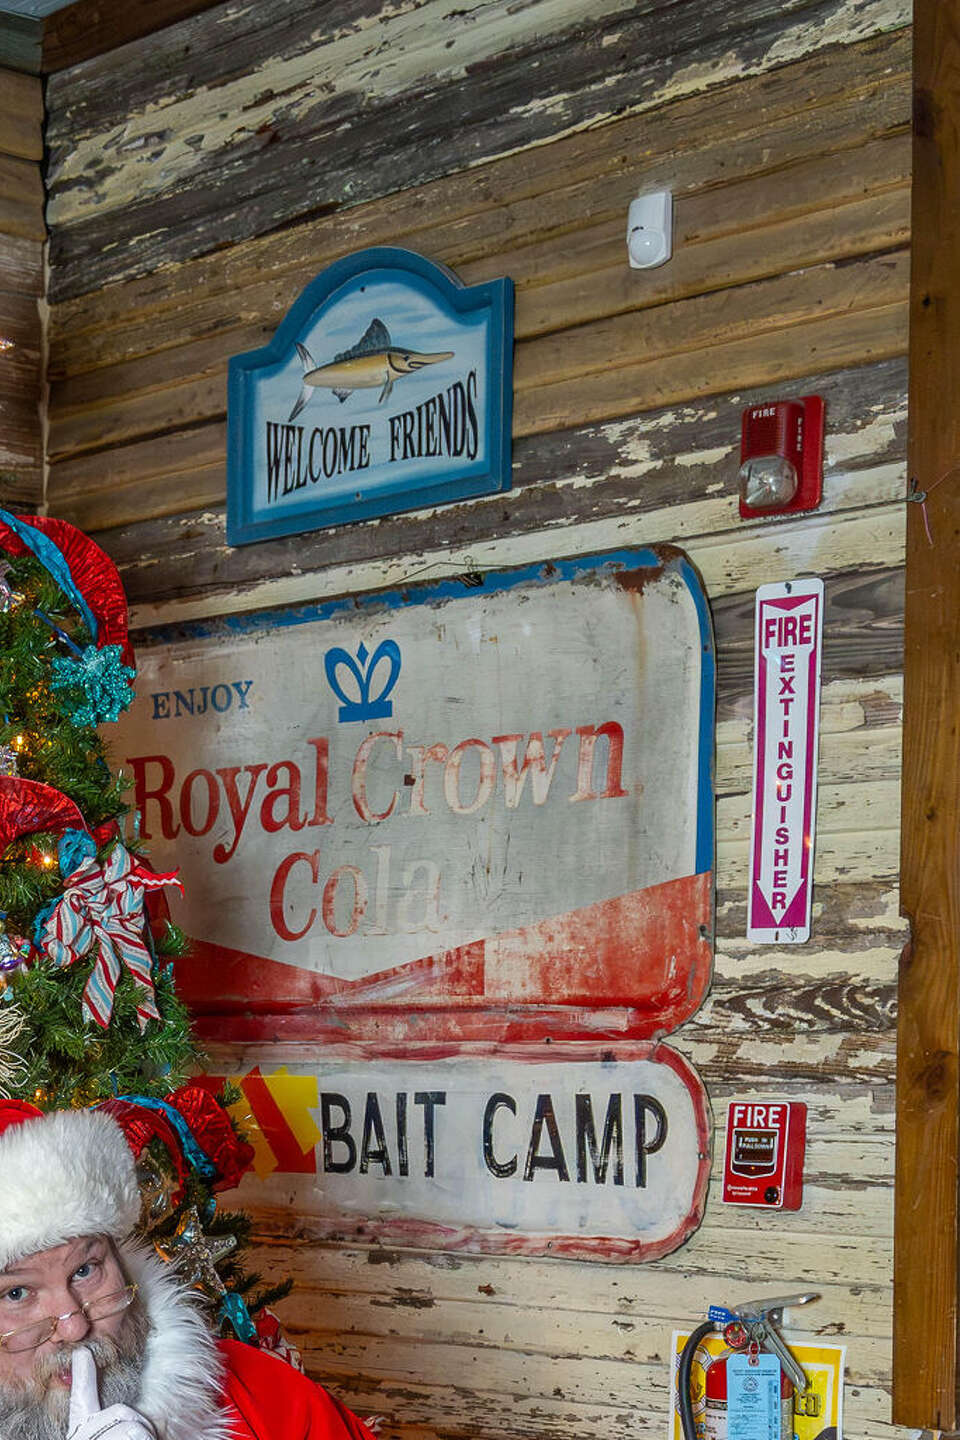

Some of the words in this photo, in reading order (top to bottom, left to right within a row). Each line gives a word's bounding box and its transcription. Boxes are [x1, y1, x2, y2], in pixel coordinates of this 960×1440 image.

[266, 421, 371, 504] WELCOME
[388, 367, 479, 461] FRIENDS
[752, 408, 775, 418] FIRE
[764, 614, 812, 649] FIRE
[151, 680, 254, 720] ENJOY
[126, 736, 335, 864] Royal
[351, 719, 630, 824] Crown
[771, 654, 796, 910] EXTINGUISHER
[269, 844, 442, 942] Cola
[320, 1091, 447, 1178] BAIT
[482, 1092, 669, 1188] CAMP
[733, 1106, 781, 1127] FIRE
